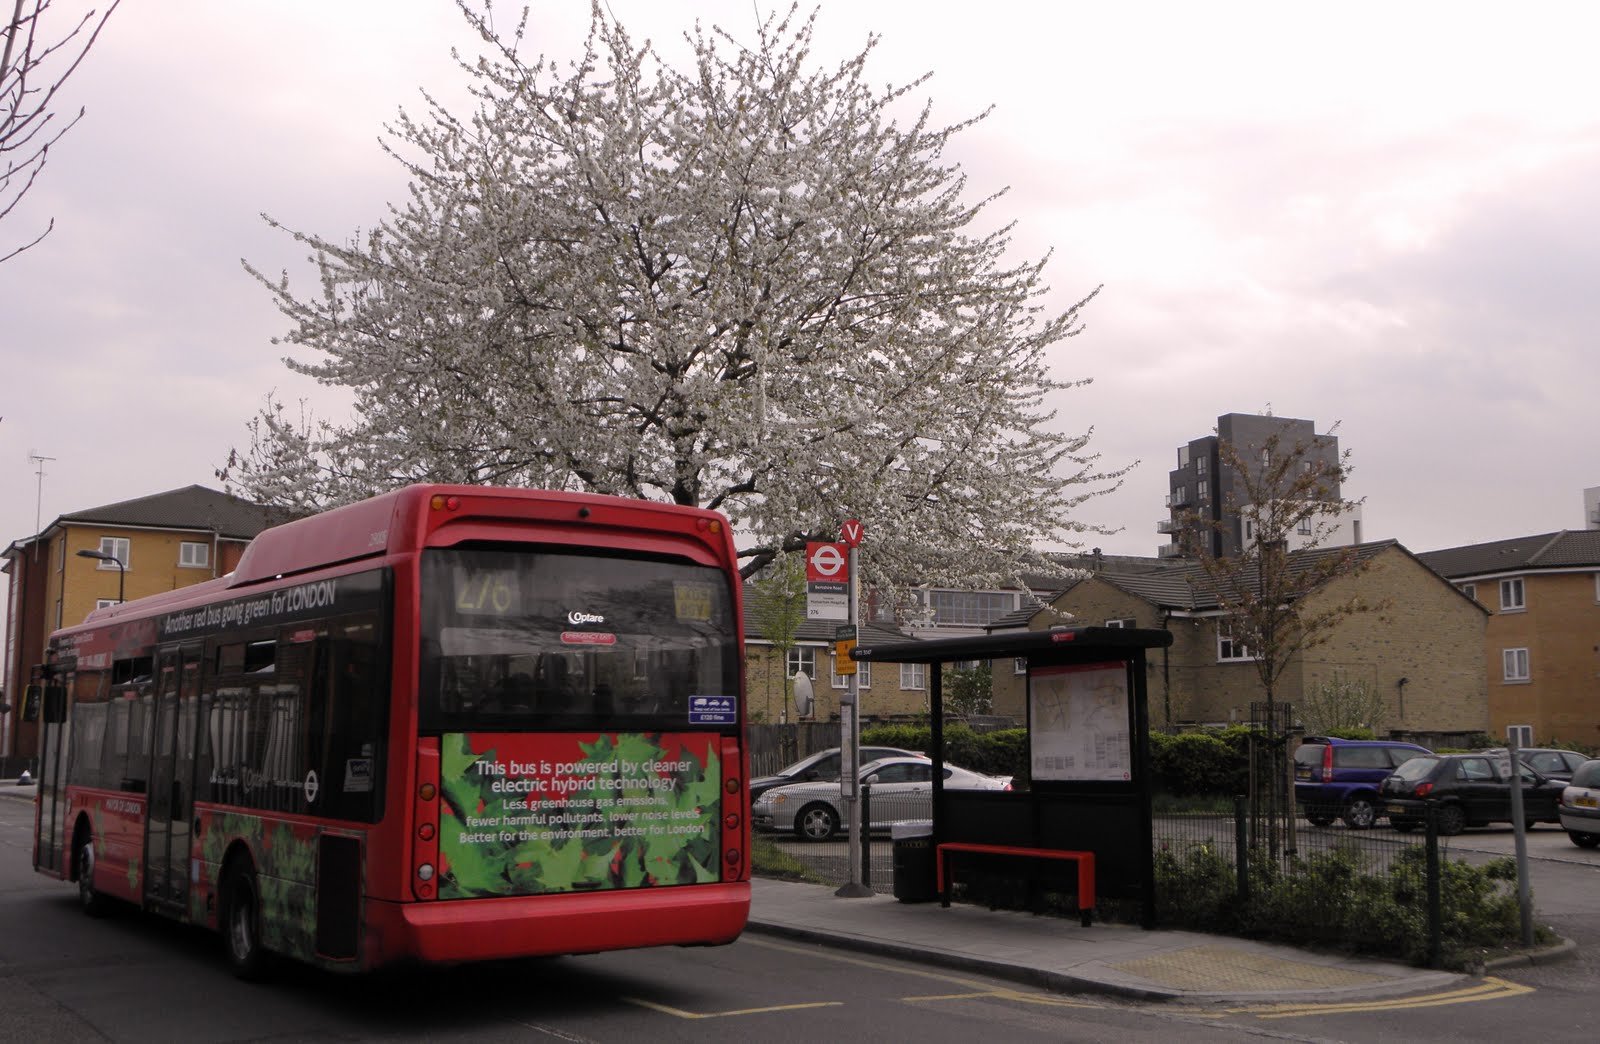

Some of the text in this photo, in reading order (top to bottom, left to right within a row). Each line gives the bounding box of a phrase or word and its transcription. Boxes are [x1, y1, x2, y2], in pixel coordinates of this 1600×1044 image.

[846, 524, 860, 541] V
[164, 580, 337, 634] Another red bus going green for LONDON
[573, 612, 605, 624] Optare
[475, 758, 692, 777] This bus is powered by cleaner
[491, 775, 678, 795] electric hybrid technology
[503, 798, 528, 810] Less
[530, 797, 594, 812] greenhouse
[596, 798, 615, 809] gas
[465, 815, 501, 827] fewer
[503, 813, 547, 826] harmful
[609, 811, 640, 822] lower
[641, 810, 669, 821] noise
[671, 809, 701, 820] levels
[459, 832, 497, 844] Better
[499, 830, 517, 842] for
[519, 829, 538, 841] the
[614, 826, 647, 837] better
[649, 824, 666, 835] for
[667, 823, 705, 834] London
